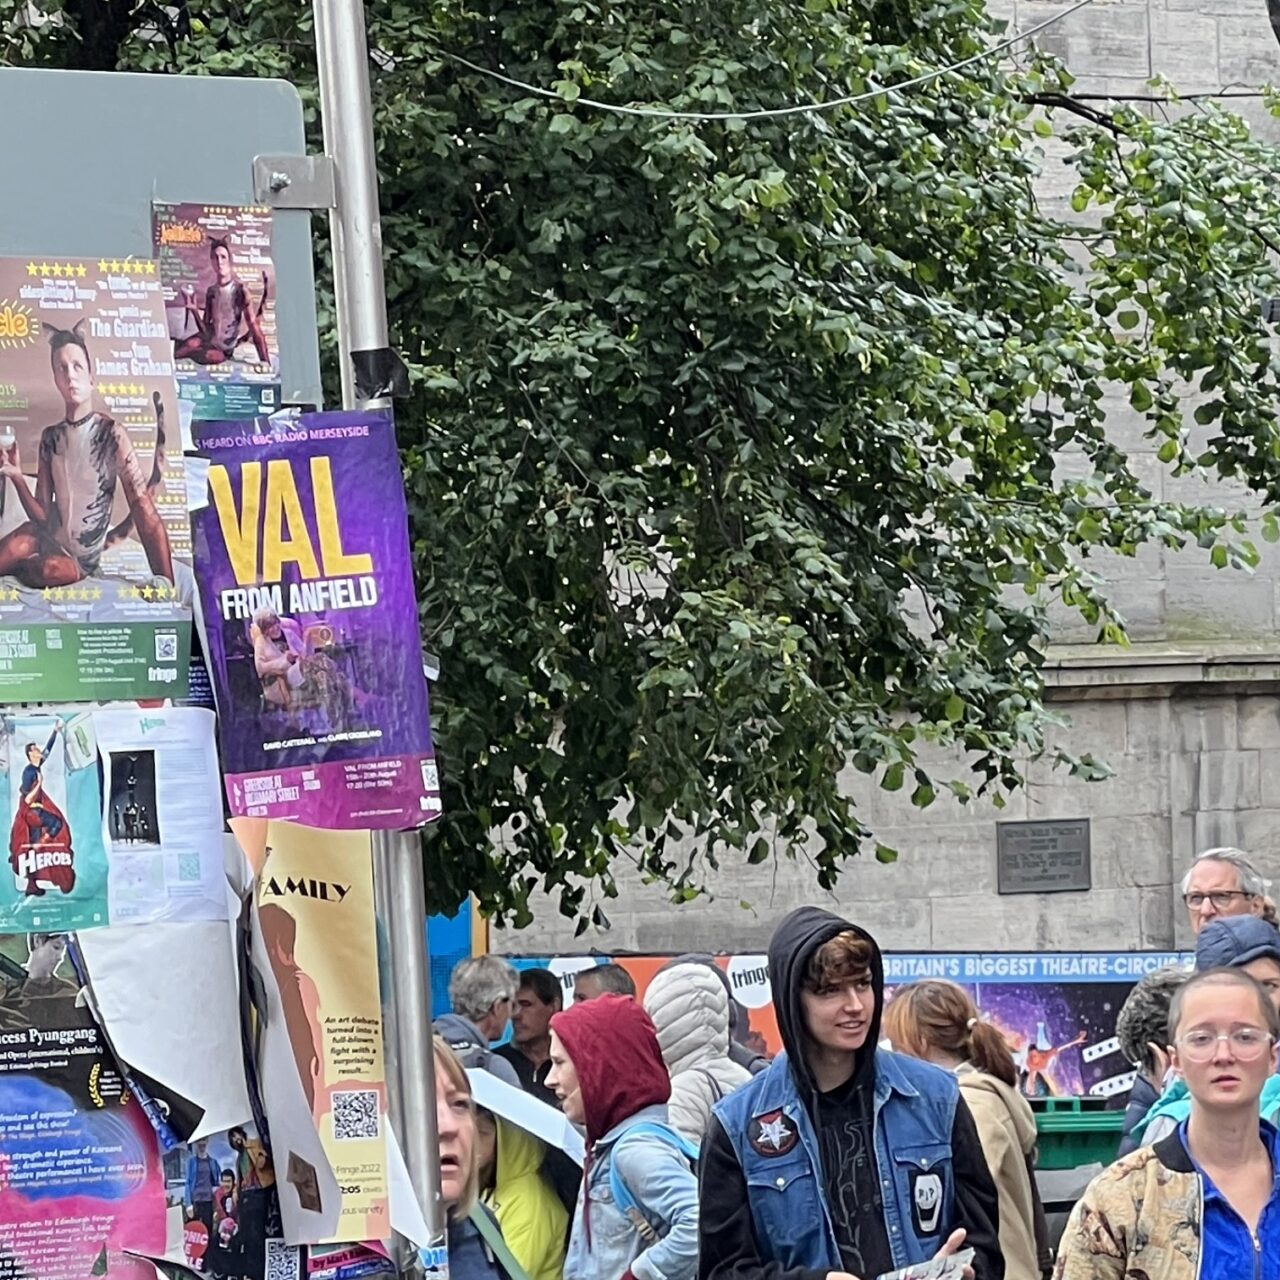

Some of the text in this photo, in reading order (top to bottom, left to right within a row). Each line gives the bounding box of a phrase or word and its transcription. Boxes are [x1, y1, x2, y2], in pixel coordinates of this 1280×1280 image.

[89, 317, 166, 338] The Guardian
[95, 357, 172, 376] James Graham
[202, 437, 233, 449] HEARD
[235, 436, 250, 448] ON
[252, 434, 273, 446] BBC
[275, 431, 308, 444] RADIO
[309, 426, 369, 441] MERSEYSIDE
[207, 456, 374, 586] VAL
[221, 576, 378, 620] FROM ANFIELD
[262, 876, 352, 904] AMILY
[883, 957, 960, 977] BRITAIN'S
[964, 957, 1037, 977] BIGGEST
[731, 966, 770, 990] fring
[28, 1028, 97, 1046] Pyunggang
[360, 1163, 381, 1173] 2022
[313, 1259, 325, 1268] by
